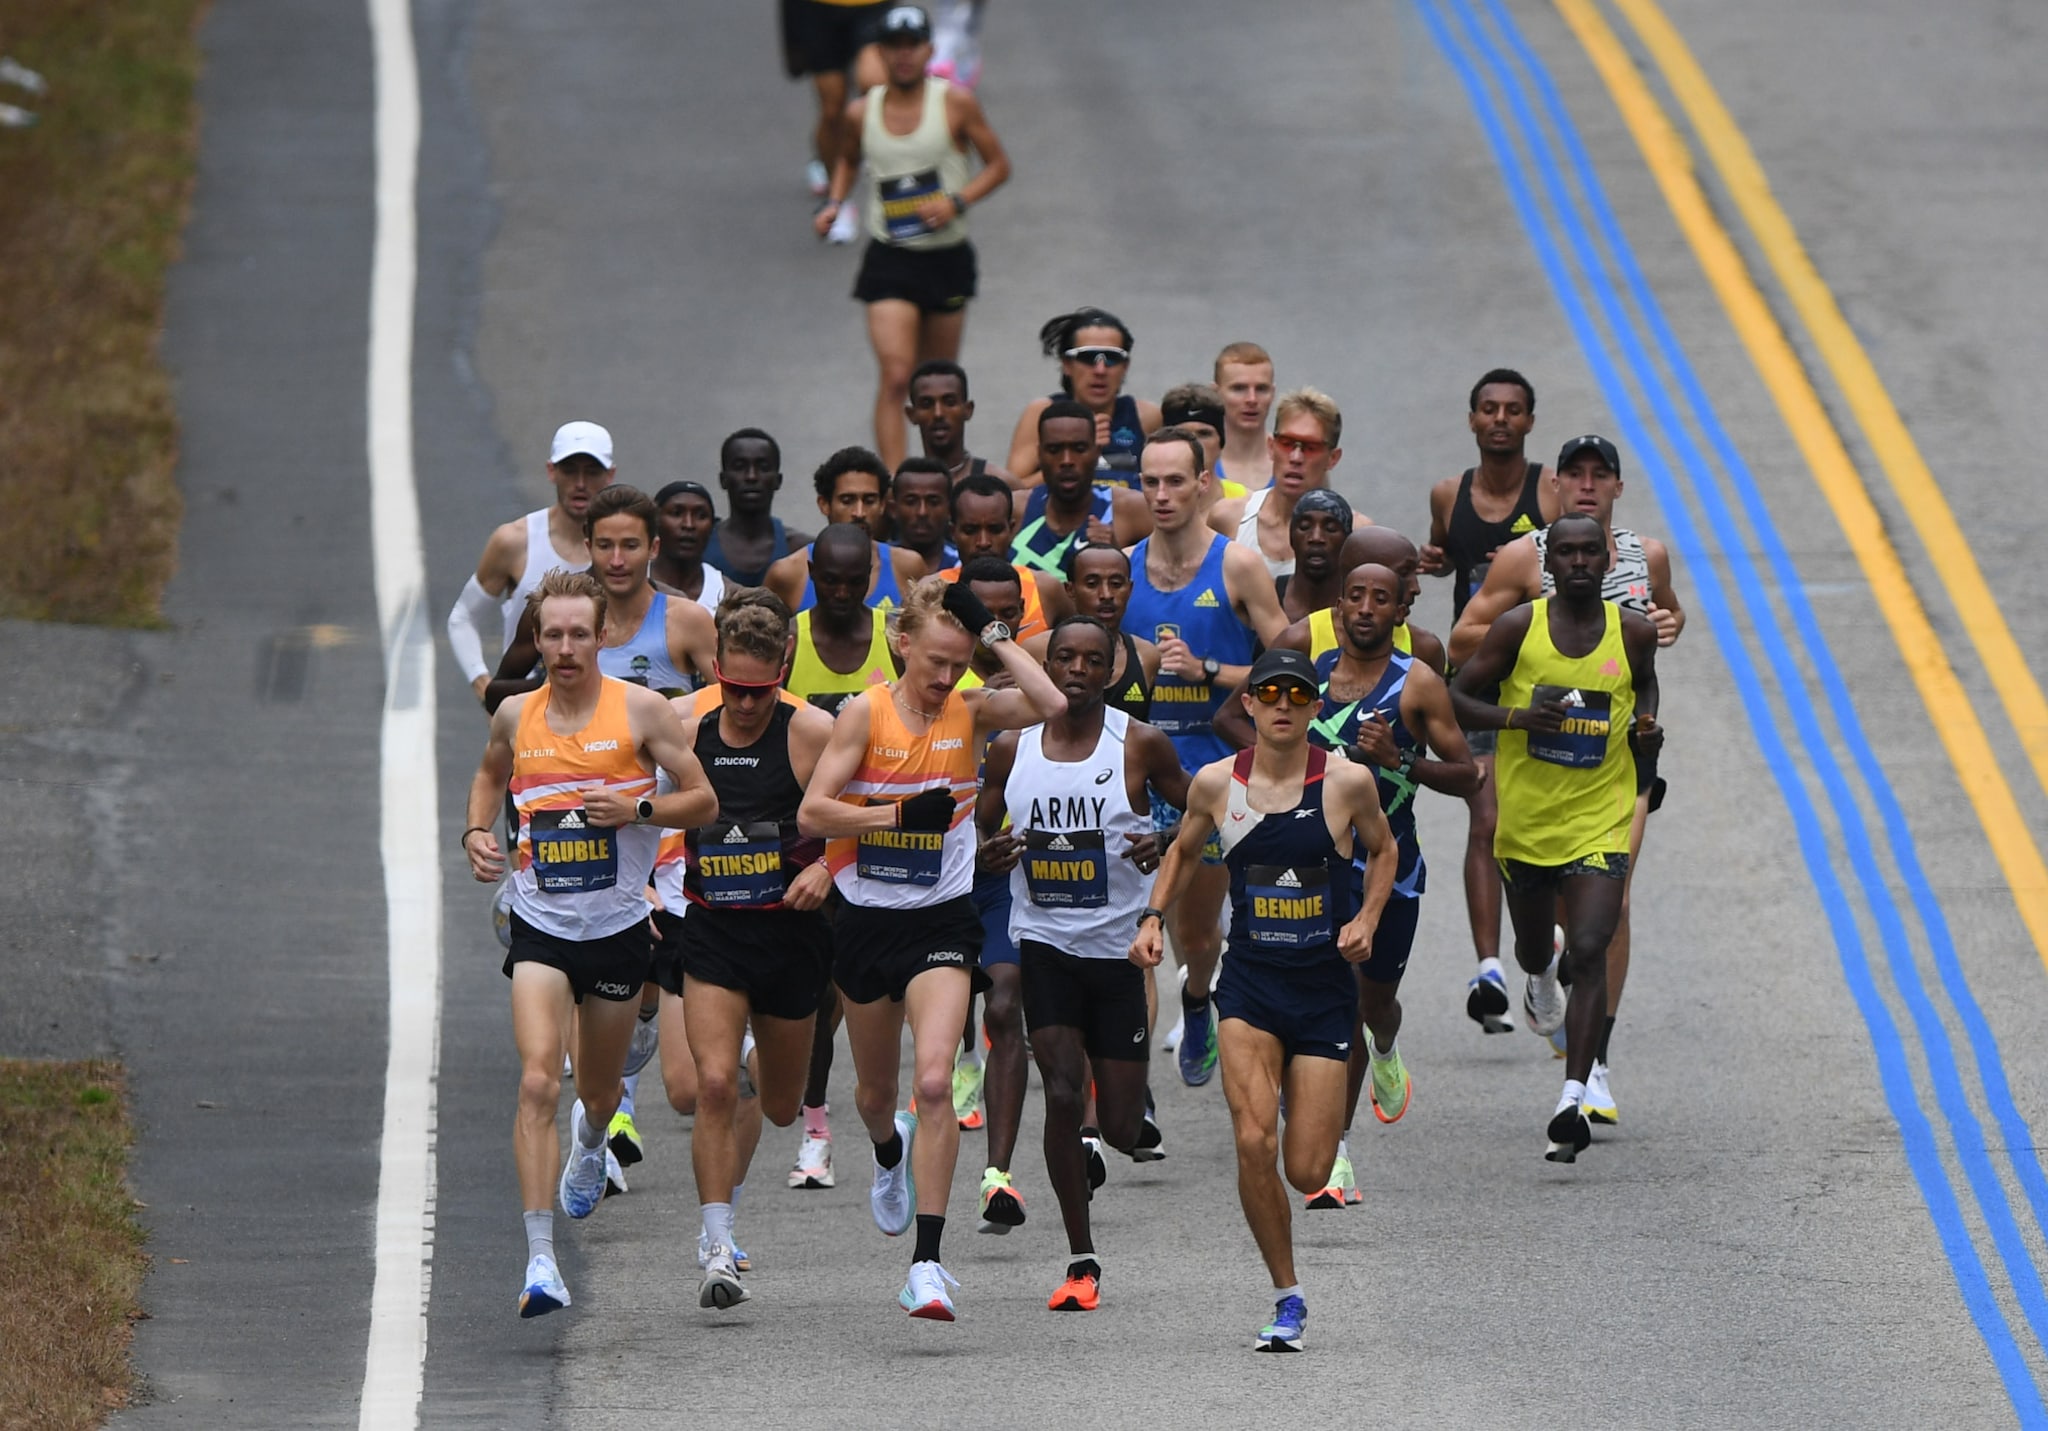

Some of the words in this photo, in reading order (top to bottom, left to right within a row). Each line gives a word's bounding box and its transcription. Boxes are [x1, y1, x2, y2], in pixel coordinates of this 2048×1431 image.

[534, 748, 556, 757] ELITE
[583, 739, 618, 752] HOKA
[932, 738, 964, 752] HOKA
[885, 748, 910, 759] ELITE
[714, 756, 760, 768] saucony
[1030, 796, 1106, 829] ARMY
[860, 830, 943, 851] LINKLETTER
[538, 838, 610, 864] FAUBLE
[699, 851, 781, 877] STINSON
[1031, 860, 1096, 881] MAIYO
[1275, 880, 1303, 888] adidas
[1254, 895, 1323, 920] BENNIE
[927, 951, 964, 964] HOKA
[595, 980, 630, 996] HOKA
